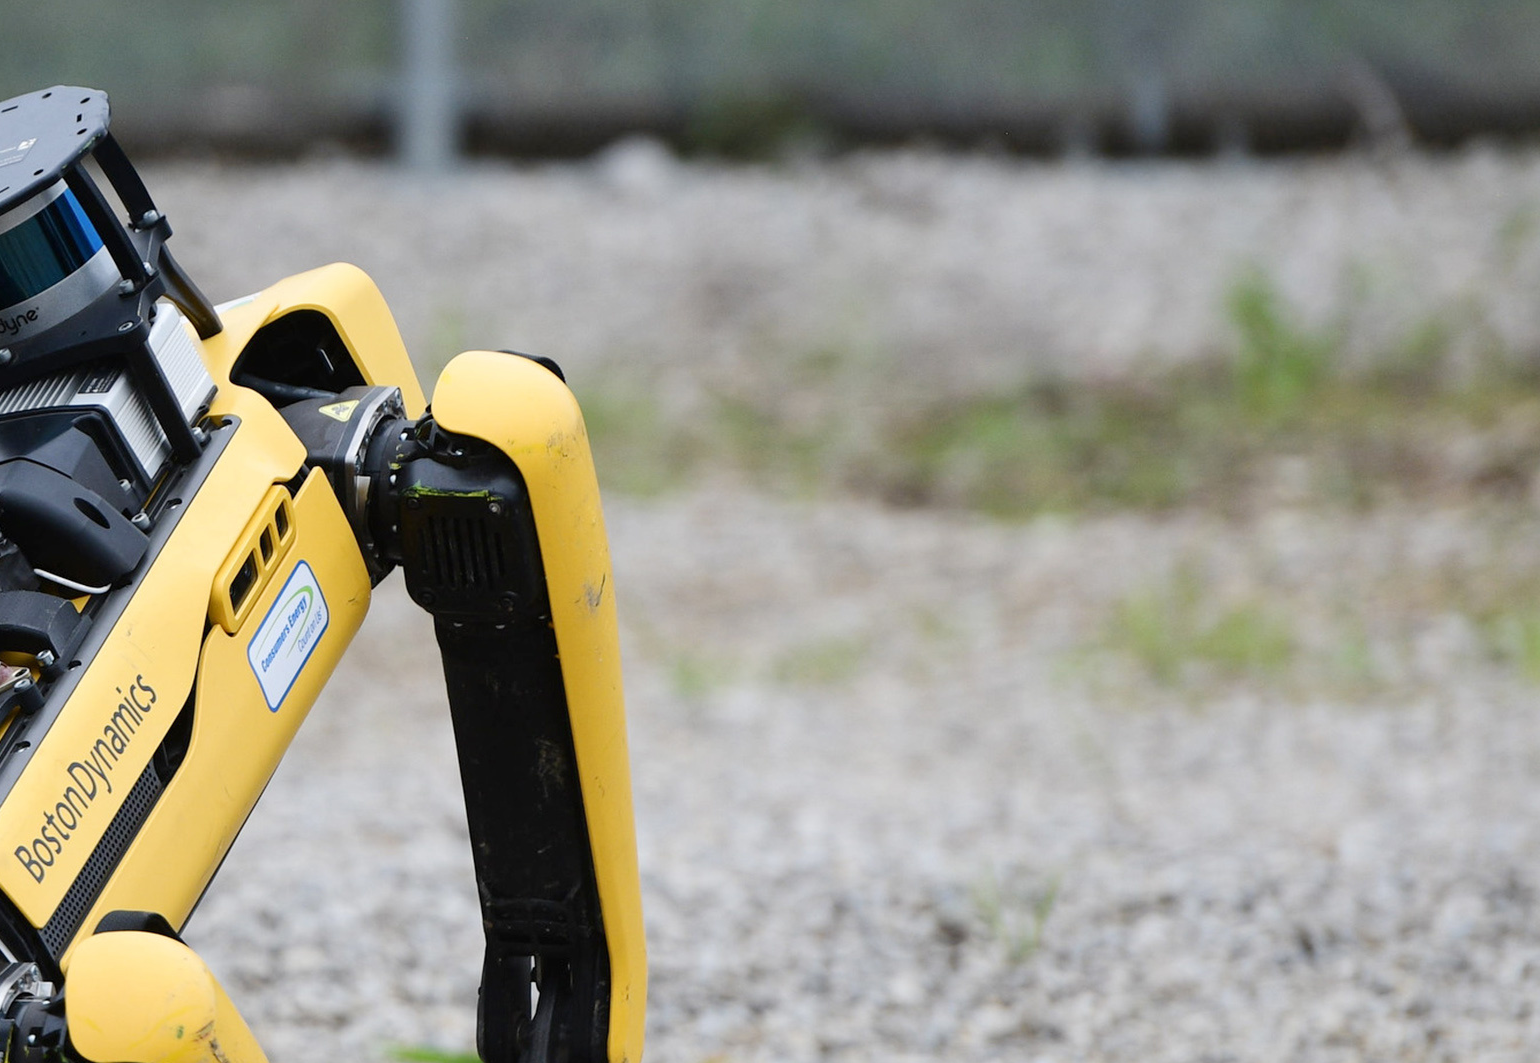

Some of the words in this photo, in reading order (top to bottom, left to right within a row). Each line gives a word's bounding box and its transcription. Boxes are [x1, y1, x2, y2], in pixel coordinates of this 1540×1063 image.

[261, 624, 290, 673] Consumers
[287, 595, 308, 627] Energy
[297, 627, 313, 653] Count
[14, 674, 157, 884] BostonDynamics
